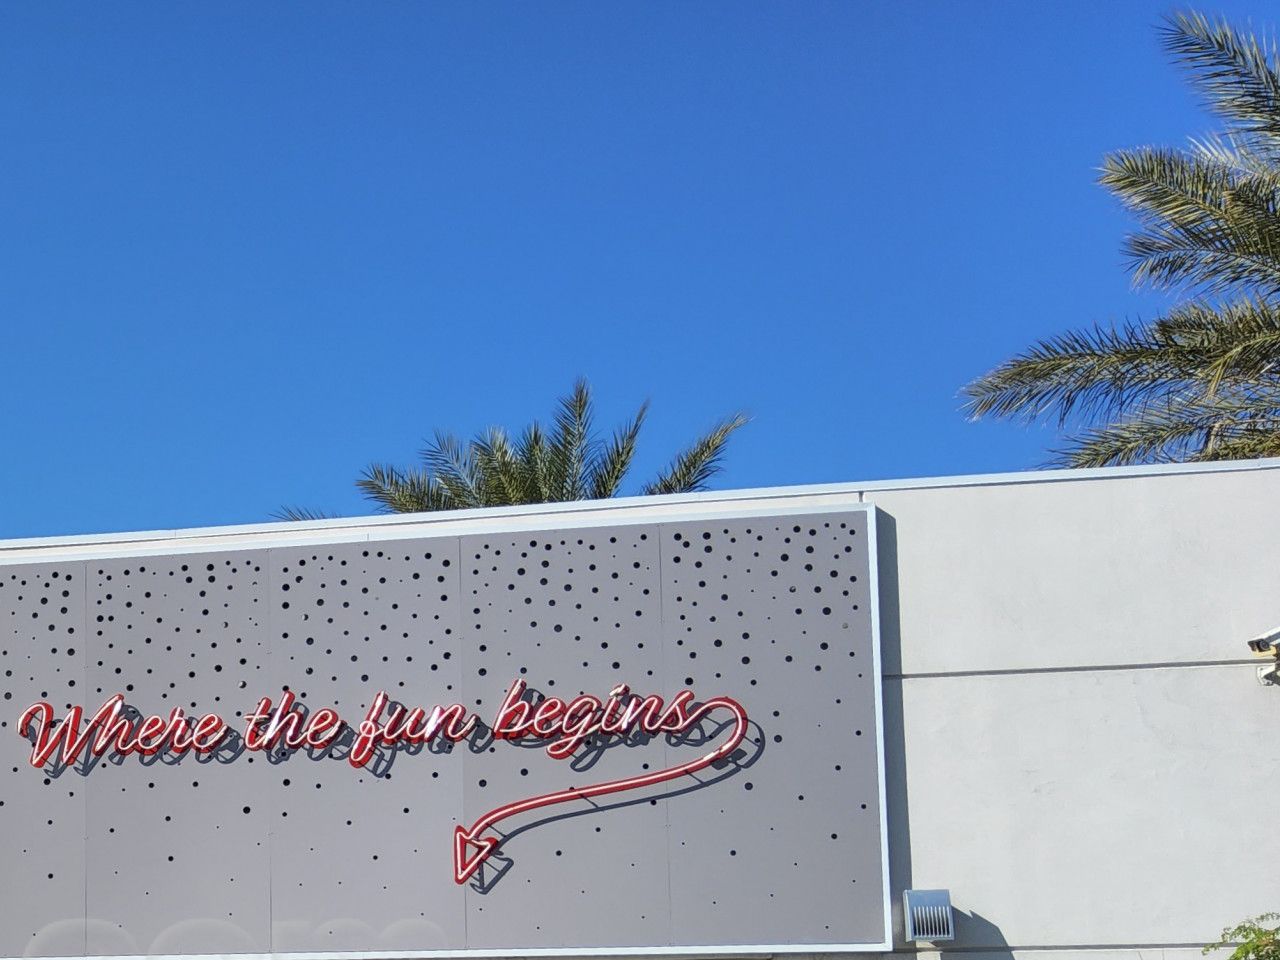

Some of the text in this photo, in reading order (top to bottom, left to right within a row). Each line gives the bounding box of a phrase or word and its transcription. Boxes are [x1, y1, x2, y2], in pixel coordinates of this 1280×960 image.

[17, 677, 696, 769] Where the fun begins
